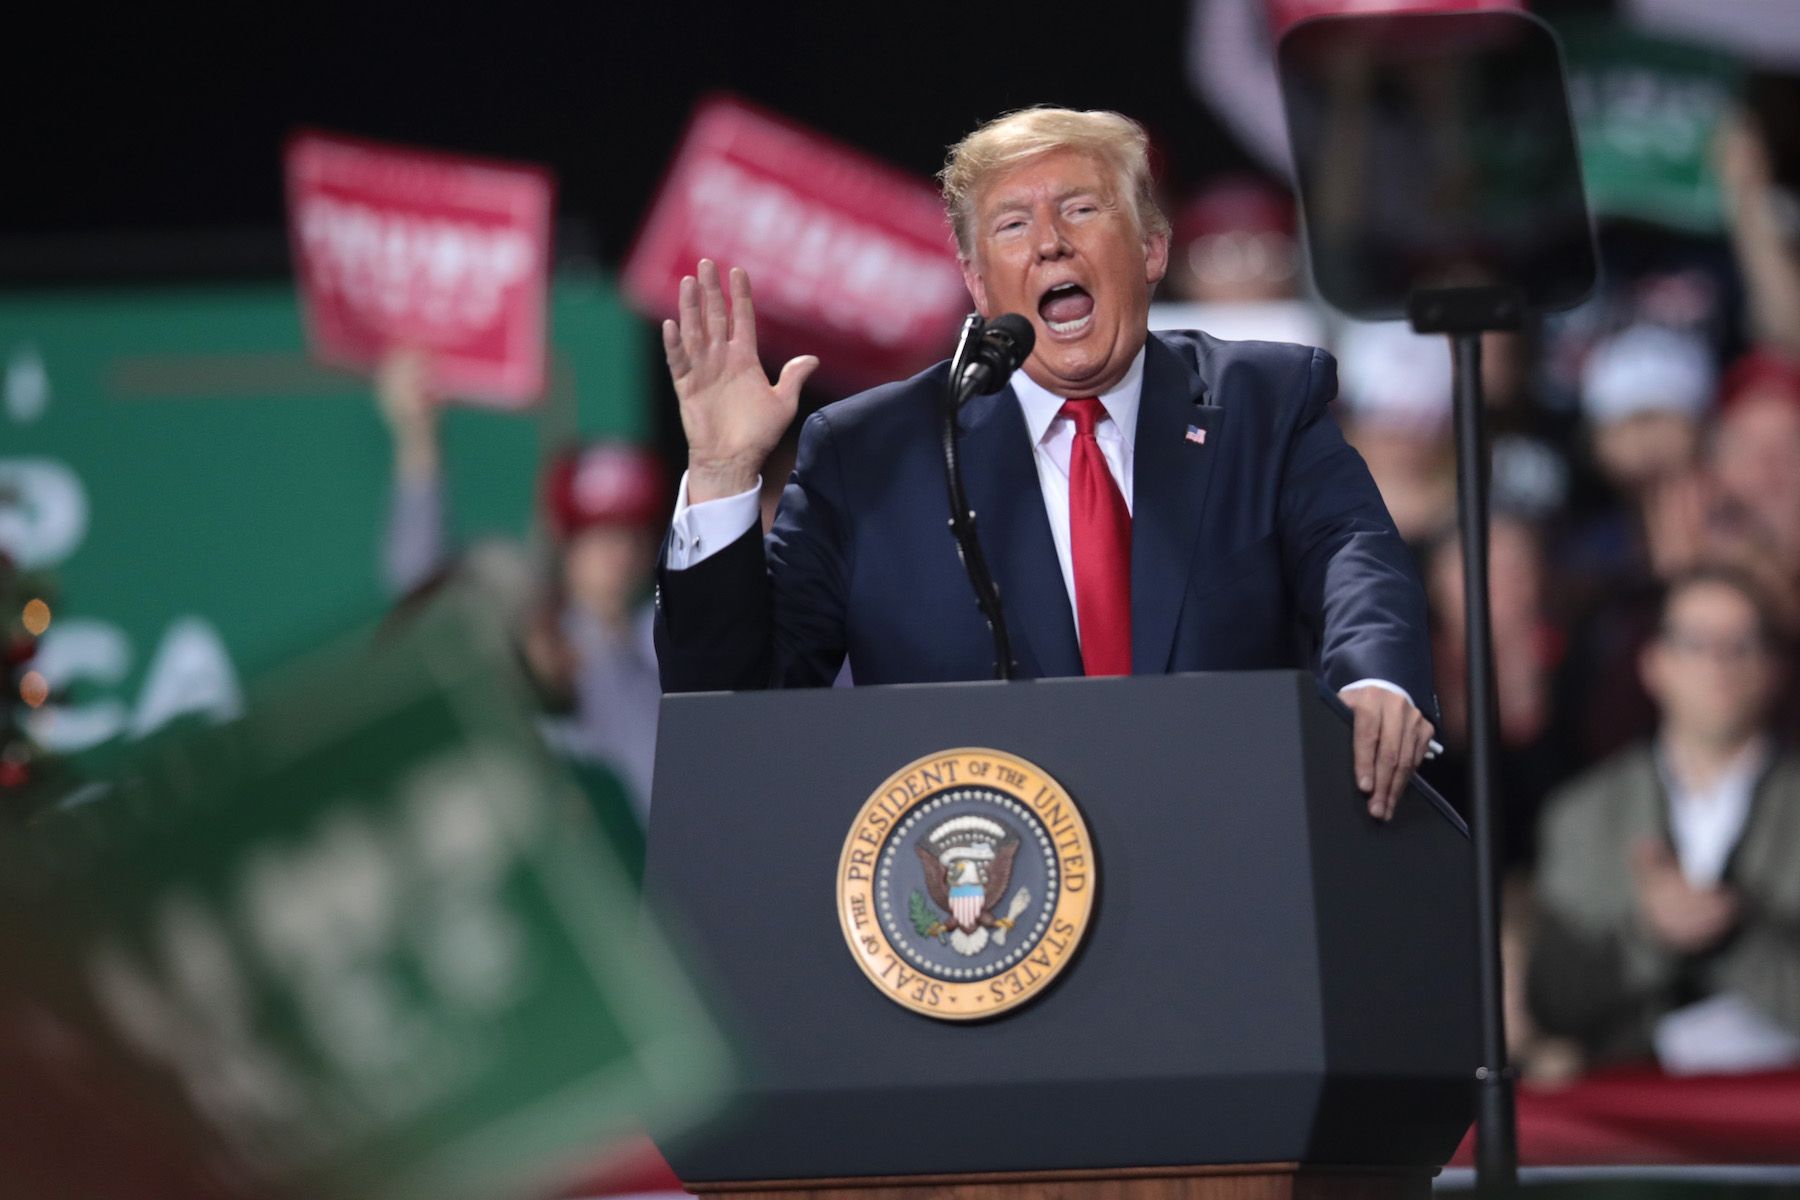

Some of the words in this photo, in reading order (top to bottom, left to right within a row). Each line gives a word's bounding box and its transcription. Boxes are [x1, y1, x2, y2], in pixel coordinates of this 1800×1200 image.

[968, 761, 989, 777] OF
[996, 765, 1027, 789] THE
[848, 760, 960, 882] PRESIDENT
[1034, 786, 1086, 892] UNITED
[851, 893, 867, 930] THE
[861, 930, 880, 955] OF
[989, 919, 1074, 1002] STATES
[879, 951, 943, 1006] SEAL
